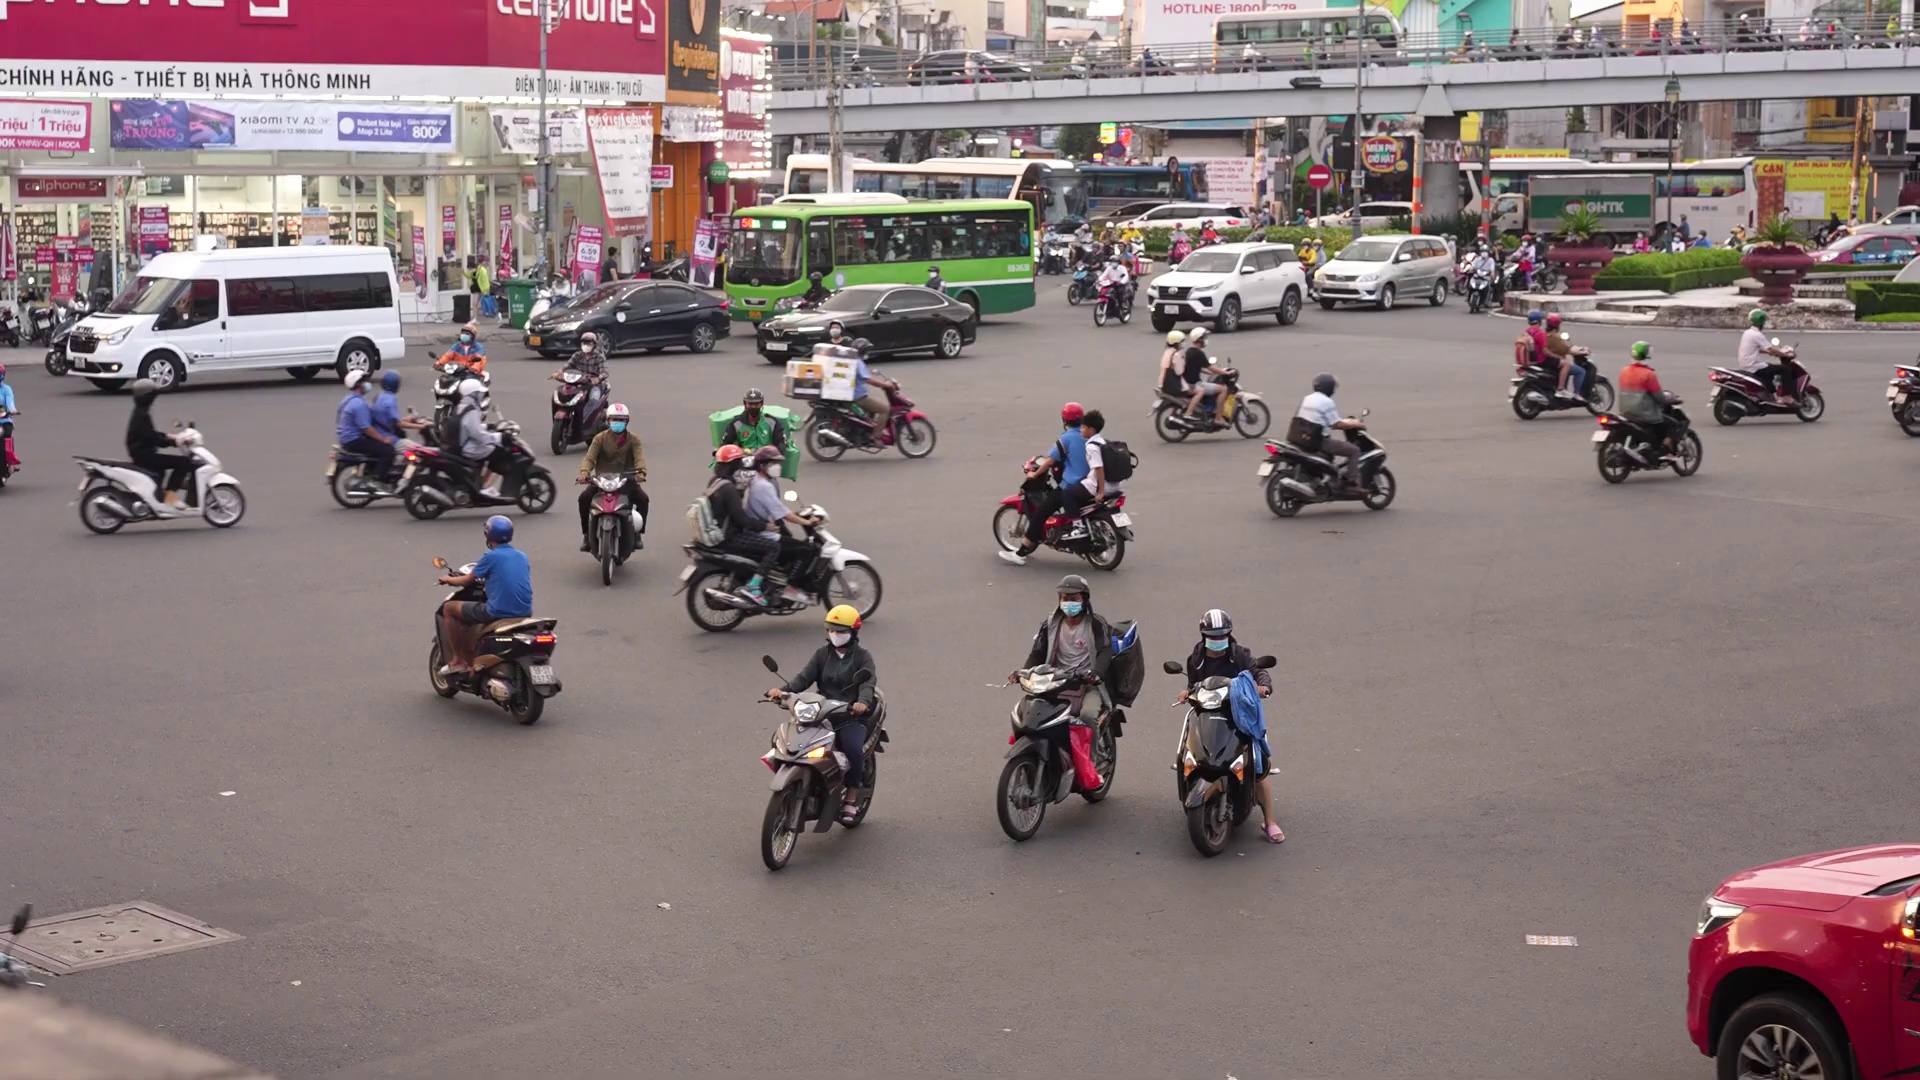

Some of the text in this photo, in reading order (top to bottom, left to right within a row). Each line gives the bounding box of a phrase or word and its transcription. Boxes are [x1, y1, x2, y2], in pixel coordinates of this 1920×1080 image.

[1163, 4, 1226, 14] HOTLINE:
[1230, 4, 1260, 12] 1800
[0, 66, 54, 86] CHÍNH
[61, 67, 114, 87] HÃNG
[134, 66, 187, 88] THIẾT
[194, 72, 210, 91] BỊ
[215, 69, 253, 89] NHÀ
[260, 69, 321, 90] THÔNG
[327, 73, 371, 90] MINH
[516, 74, 535, 96] ĐIỆN
[537, 77, 561, 96] TOẠI
[570, 76, 581, 94] ÂM
[584, 80, 610, 96] THANH
[617, 81, 631, 95] THU
[632, 80, 642, 96] CŨ
[38, 116, 82, 135] 1 Triệu
[240, 116, 282, 124] xiaomi
[286, 116, 299, 124] TV
[303, 117, 315, 125] A2
[358, 128, 372, 136] Mop
[380, 128, 393, 136] Lite
[412, 126, 442, 139] 800K
[0, 138, 16, 148] 0K
[25, 180, 86, 194] cellphone
[1585, 201, 1624, 214] GHTK
